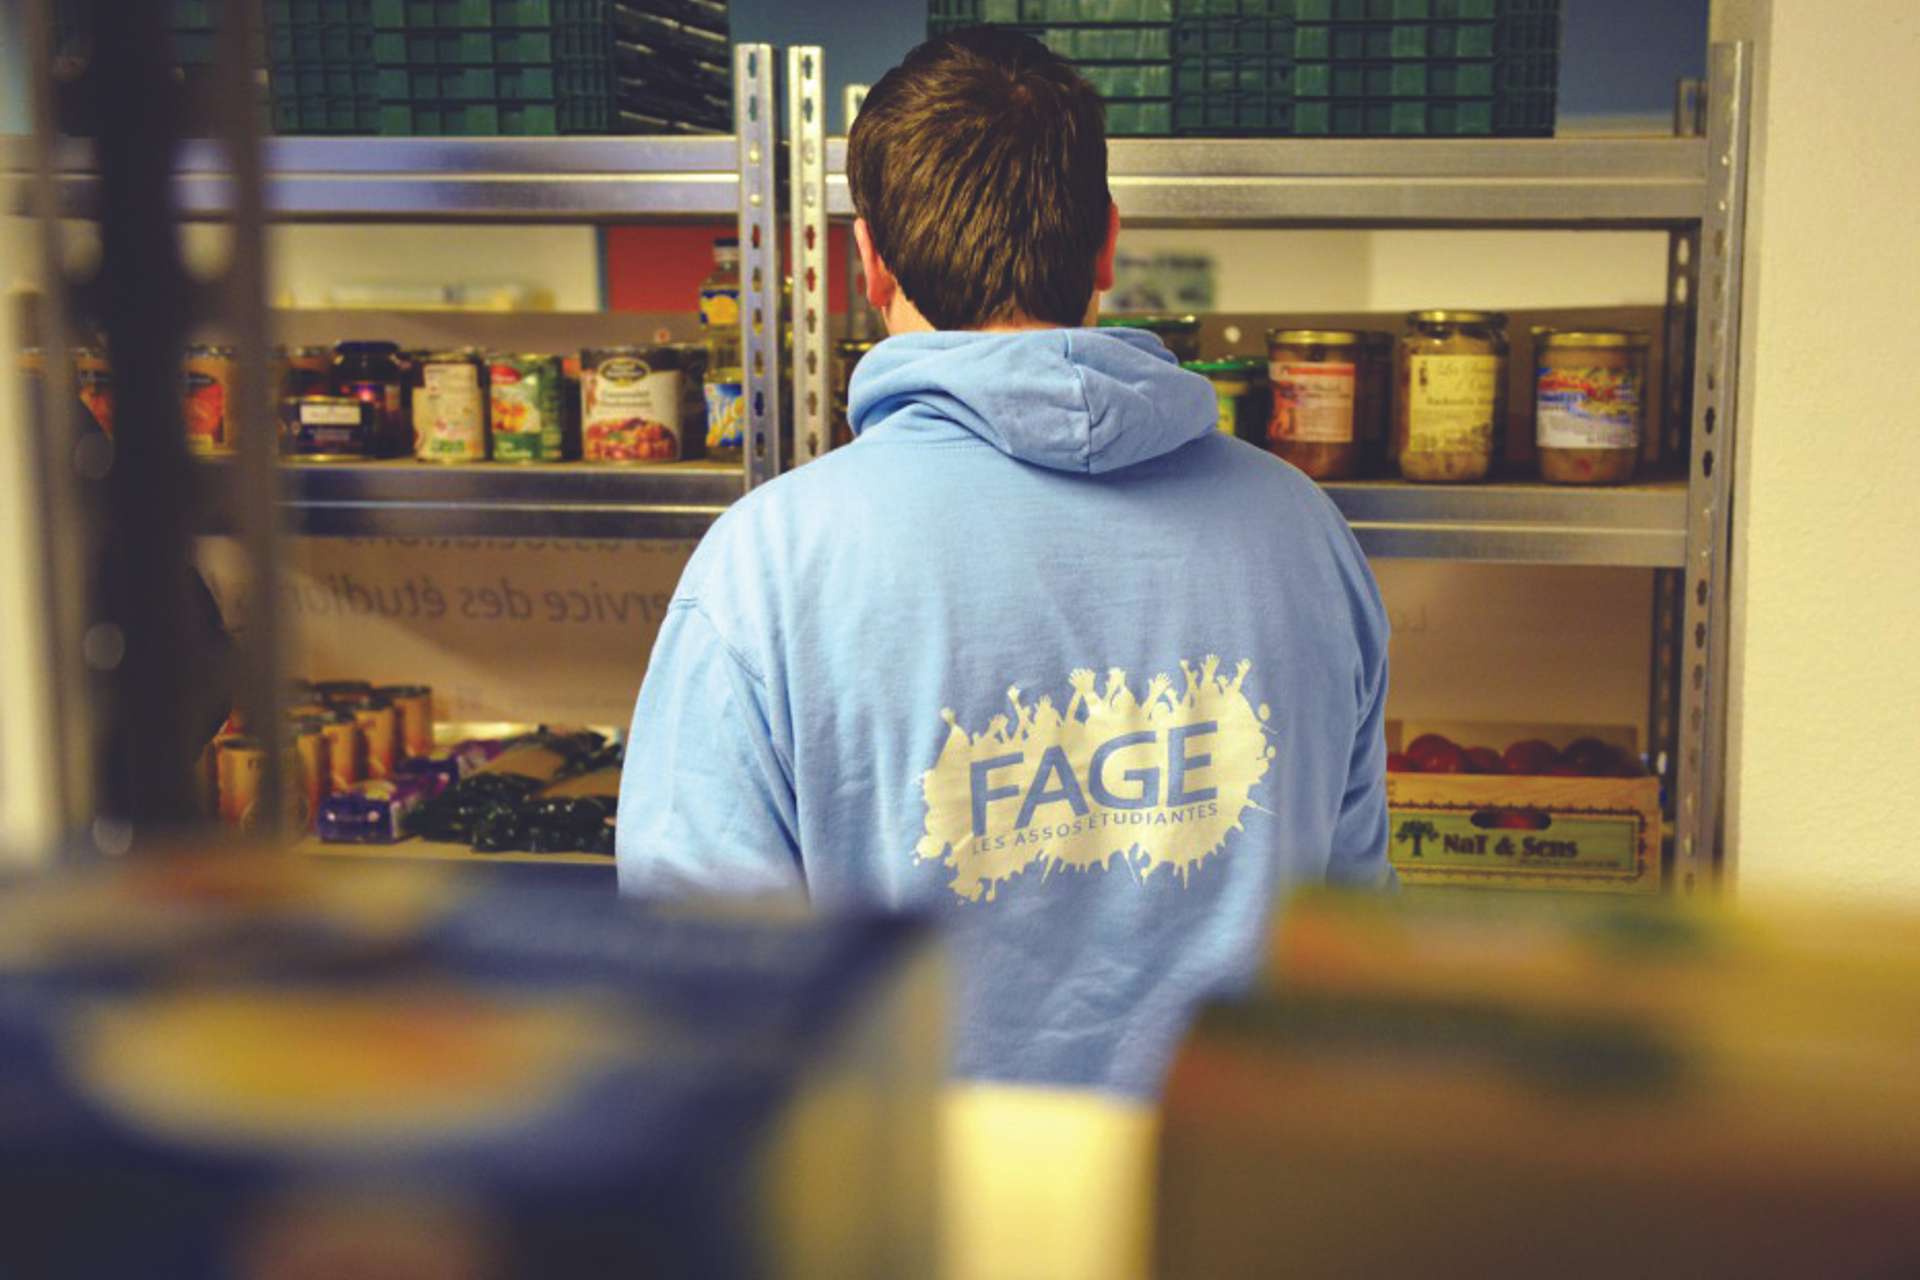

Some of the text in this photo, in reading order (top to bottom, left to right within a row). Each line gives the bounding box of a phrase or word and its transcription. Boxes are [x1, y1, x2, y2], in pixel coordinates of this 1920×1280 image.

[969, 719, 1219, 837] FAGE
[972, 835, 1006, 855] LES
[1014, 818, 1083, 847] ASSOS
[1494, 835, 1516, 856] &
